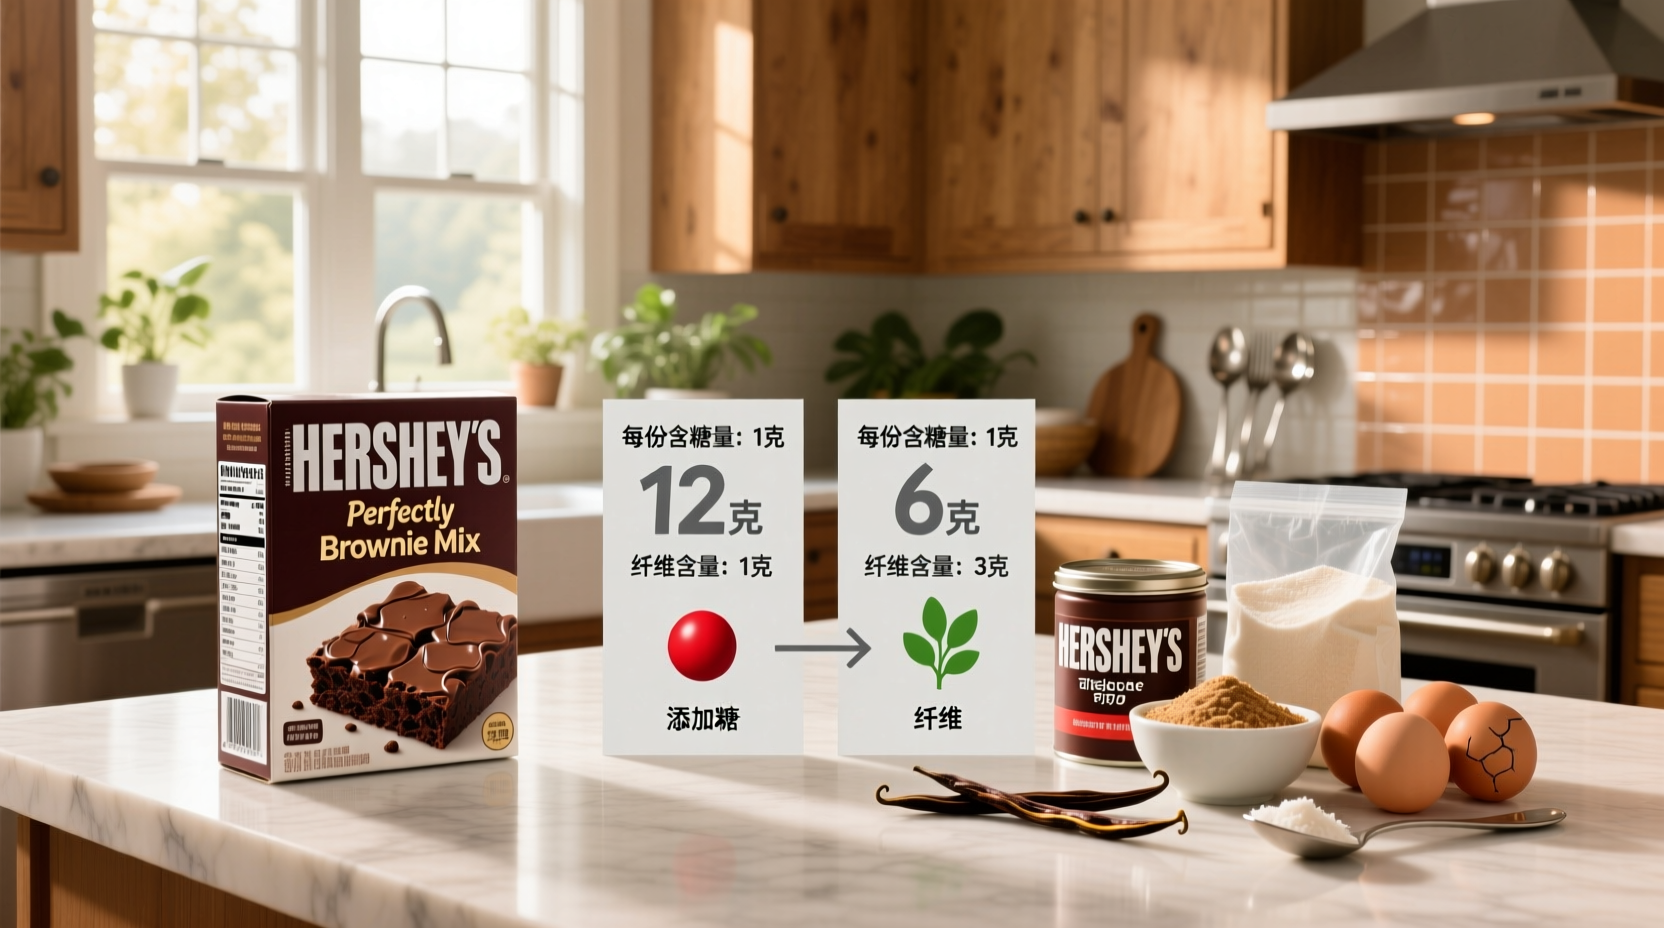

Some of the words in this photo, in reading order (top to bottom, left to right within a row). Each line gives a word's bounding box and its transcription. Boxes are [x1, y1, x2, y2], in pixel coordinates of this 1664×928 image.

[754, 425, 784, 448] 1克
[987, 425, 1018, 448] 1克
[293, 419, 501, 492] HERSHEY'S
[347, 496, 454, 530] Perfectly
[640, 465, 762, 535] 12克
[895, 463, 979, 535] 6克
[321, 531, 428, 560] Brownie
[435, 527, 480, 554] Mix
[631, 554, 727, 577] 纤维含量:
[740, 554, 772, 577] 1克
[865, 554, 961, 577] 纤维含量:
[975, 554, 1008, 577] 3克
[1058, 622, 1182, 674] HERSHEY'S
[667, 706, 740, 731] 添加糖
[914, 706, 962, 730] 纤维
